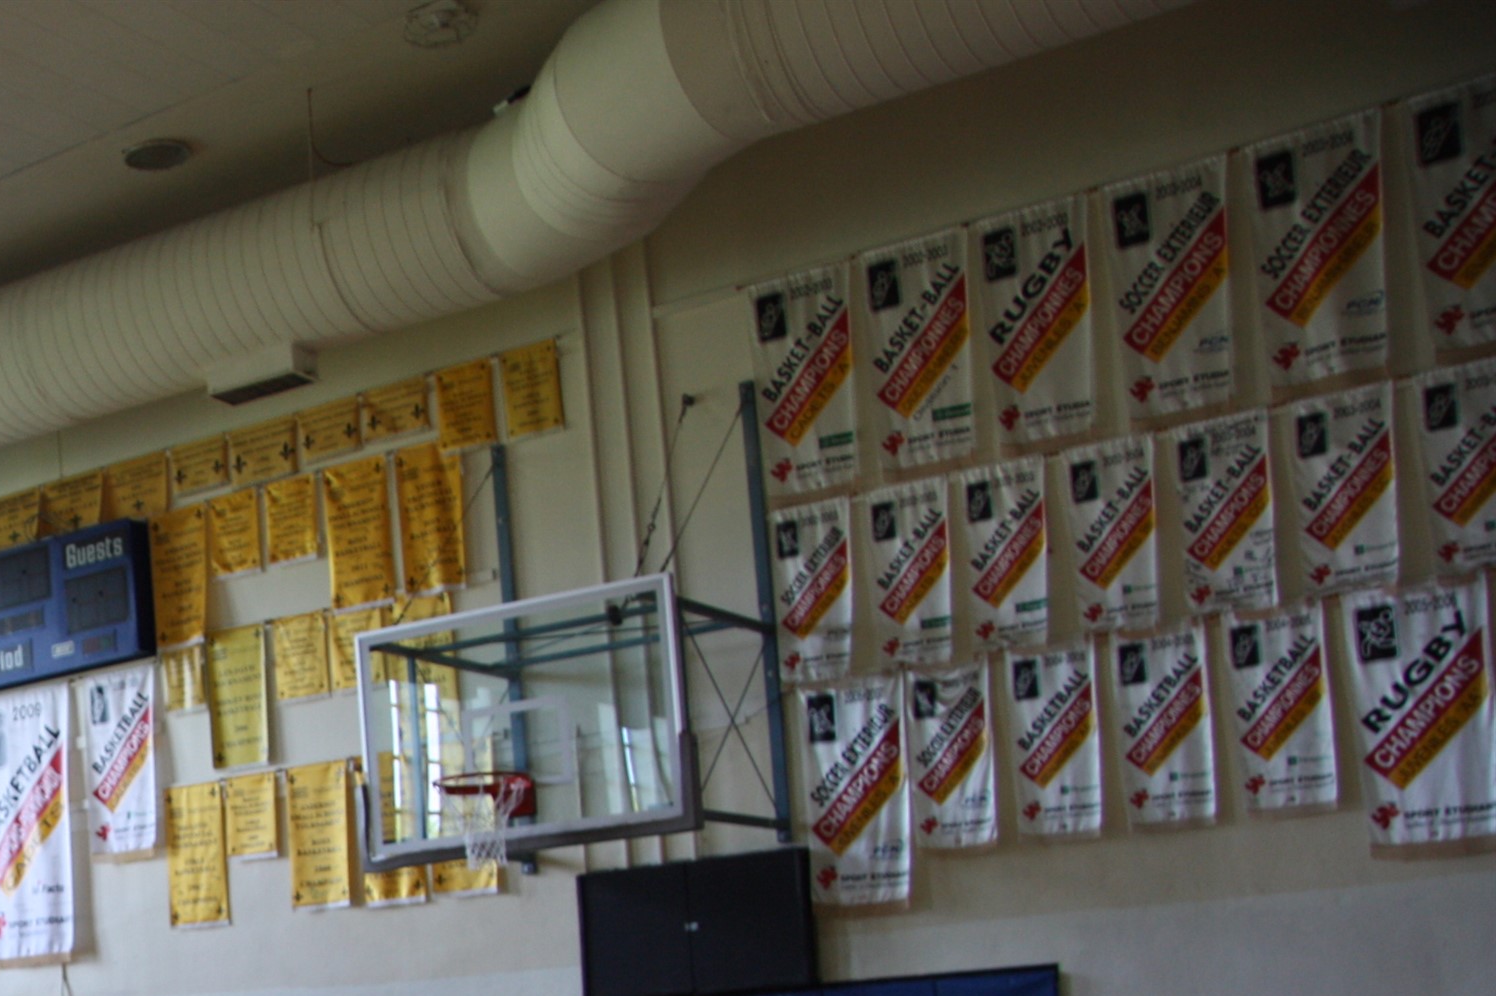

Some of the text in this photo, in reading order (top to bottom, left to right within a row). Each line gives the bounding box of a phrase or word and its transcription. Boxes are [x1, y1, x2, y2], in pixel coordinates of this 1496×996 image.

[989, 227, 1073, 345] RUGBY
[1118, 261, 1165, 315] SOCCER
[1130, 230, 1225, 346] CHAMPIONS
[1261, 223, 1311, 280] SOCCER
[1274, 188, 1376, 310] CHAMPIONNES
[760, 294, 845, 404] BASKET-BALL
[873, 262, 961, 374] BASKET-BALL
[883, 296, 966, 403] CHAMPIONNES
[998, 266, 1084, 377] CHAMPIONNES
[771, 328, 849, 433] CHAMPIONS
[1183, 444, 1263, 534] BASKET-BALL
[1302, 416, 1386, 512] BASKET-BALL
[65, 536, 124, 570] Guests
[970, 488, 1040, 572] BASKET-BALL
[1076, 465, 1149, 554] BASKET-BALL
[1192, 472, 1266, 558] CHAMPIONS
[884, 534, 946, 614] CHAMPIONS
[1017, 668, 1088, 751] BASKETBALL
[1123, 652, 1198, 739] BASKETBALL
[1236, 632, 1316, 722] BASKETBALL
[1362, 609, 1467, 734] RUGBY
[1373, 653, 1480, 769] CHAMPIONS
[91, 692, 150, 775] BASKETBALL
[98, 720, 151, 801] CHAMPIONS
[922, 714, 984, 792] CHAMPIONS
[1024, 696, 1091, 776] CHAMPIONS
[818, 741, 899, 839] CHAMPIONS
